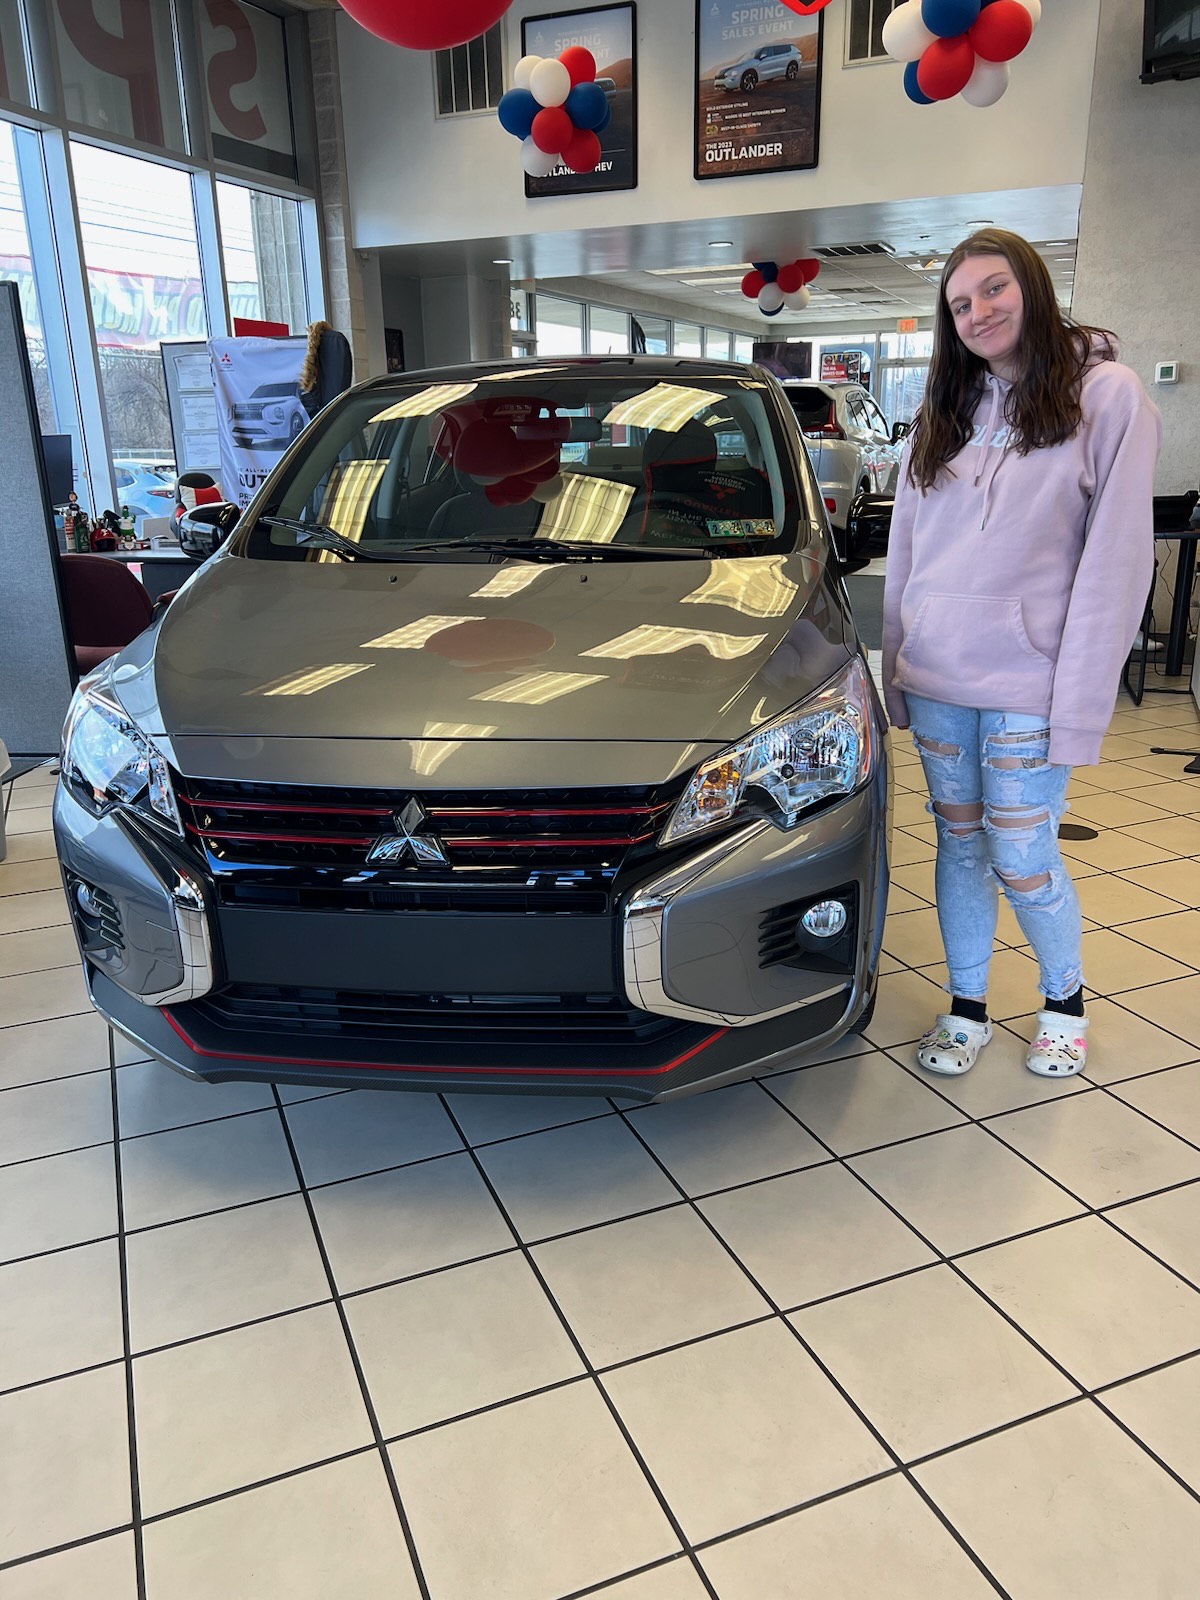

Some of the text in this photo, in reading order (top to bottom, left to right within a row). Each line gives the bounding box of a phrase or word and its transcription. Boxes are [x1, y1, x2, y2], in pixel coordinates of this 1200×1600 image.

[731, 4, 784, 25] SPRING
[721, 20, 794, 41] SALES EVENT
[554, 33, 601, 52] SPRING
[705, 142, 783, 163] OUTLANDER
